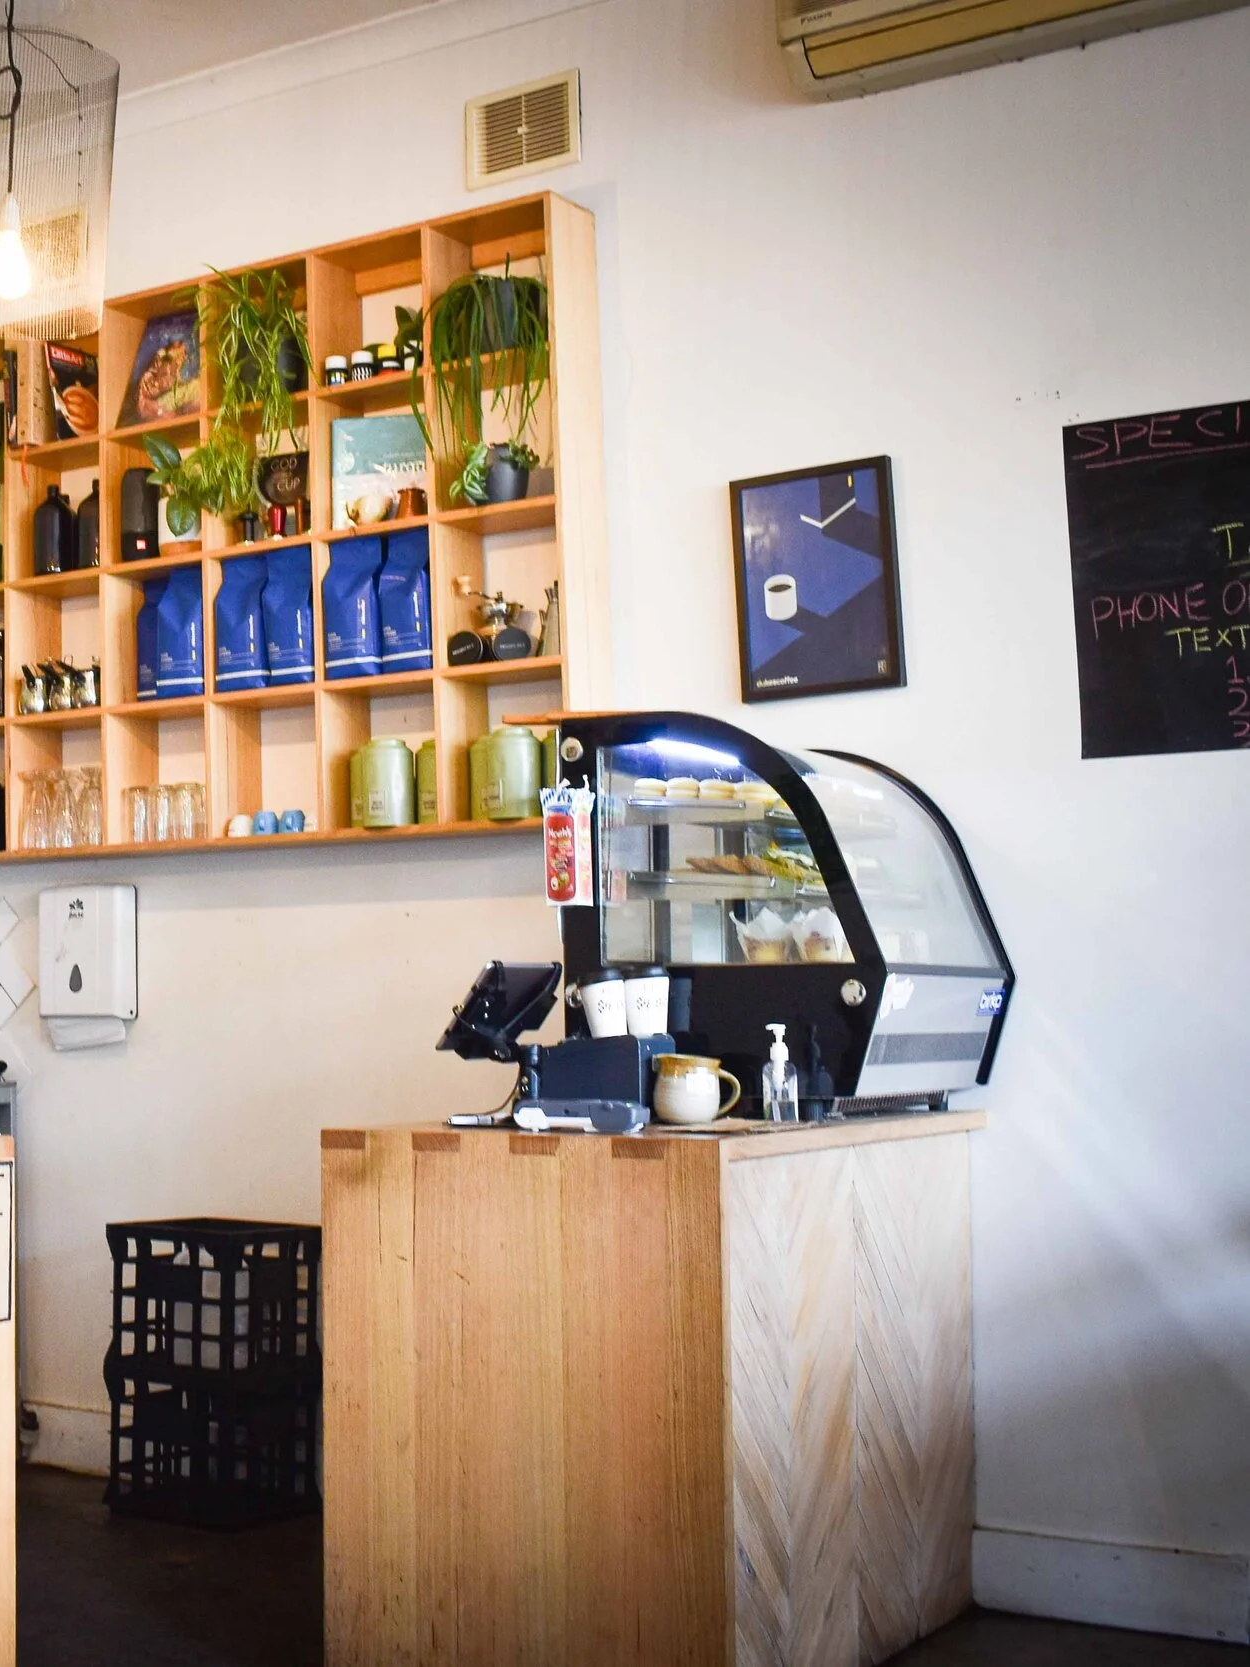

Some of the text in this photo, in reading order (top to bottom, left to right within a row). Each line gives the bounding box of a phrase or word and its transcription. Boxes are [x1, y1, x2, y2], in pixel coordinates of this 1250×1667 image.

[271, 456, 297, 471] GOD
[277, 477, 300, 492] CUP
[1091, 580, 1250, 640] PHONE O
[1165, 624, 1250, 658] TEXT
